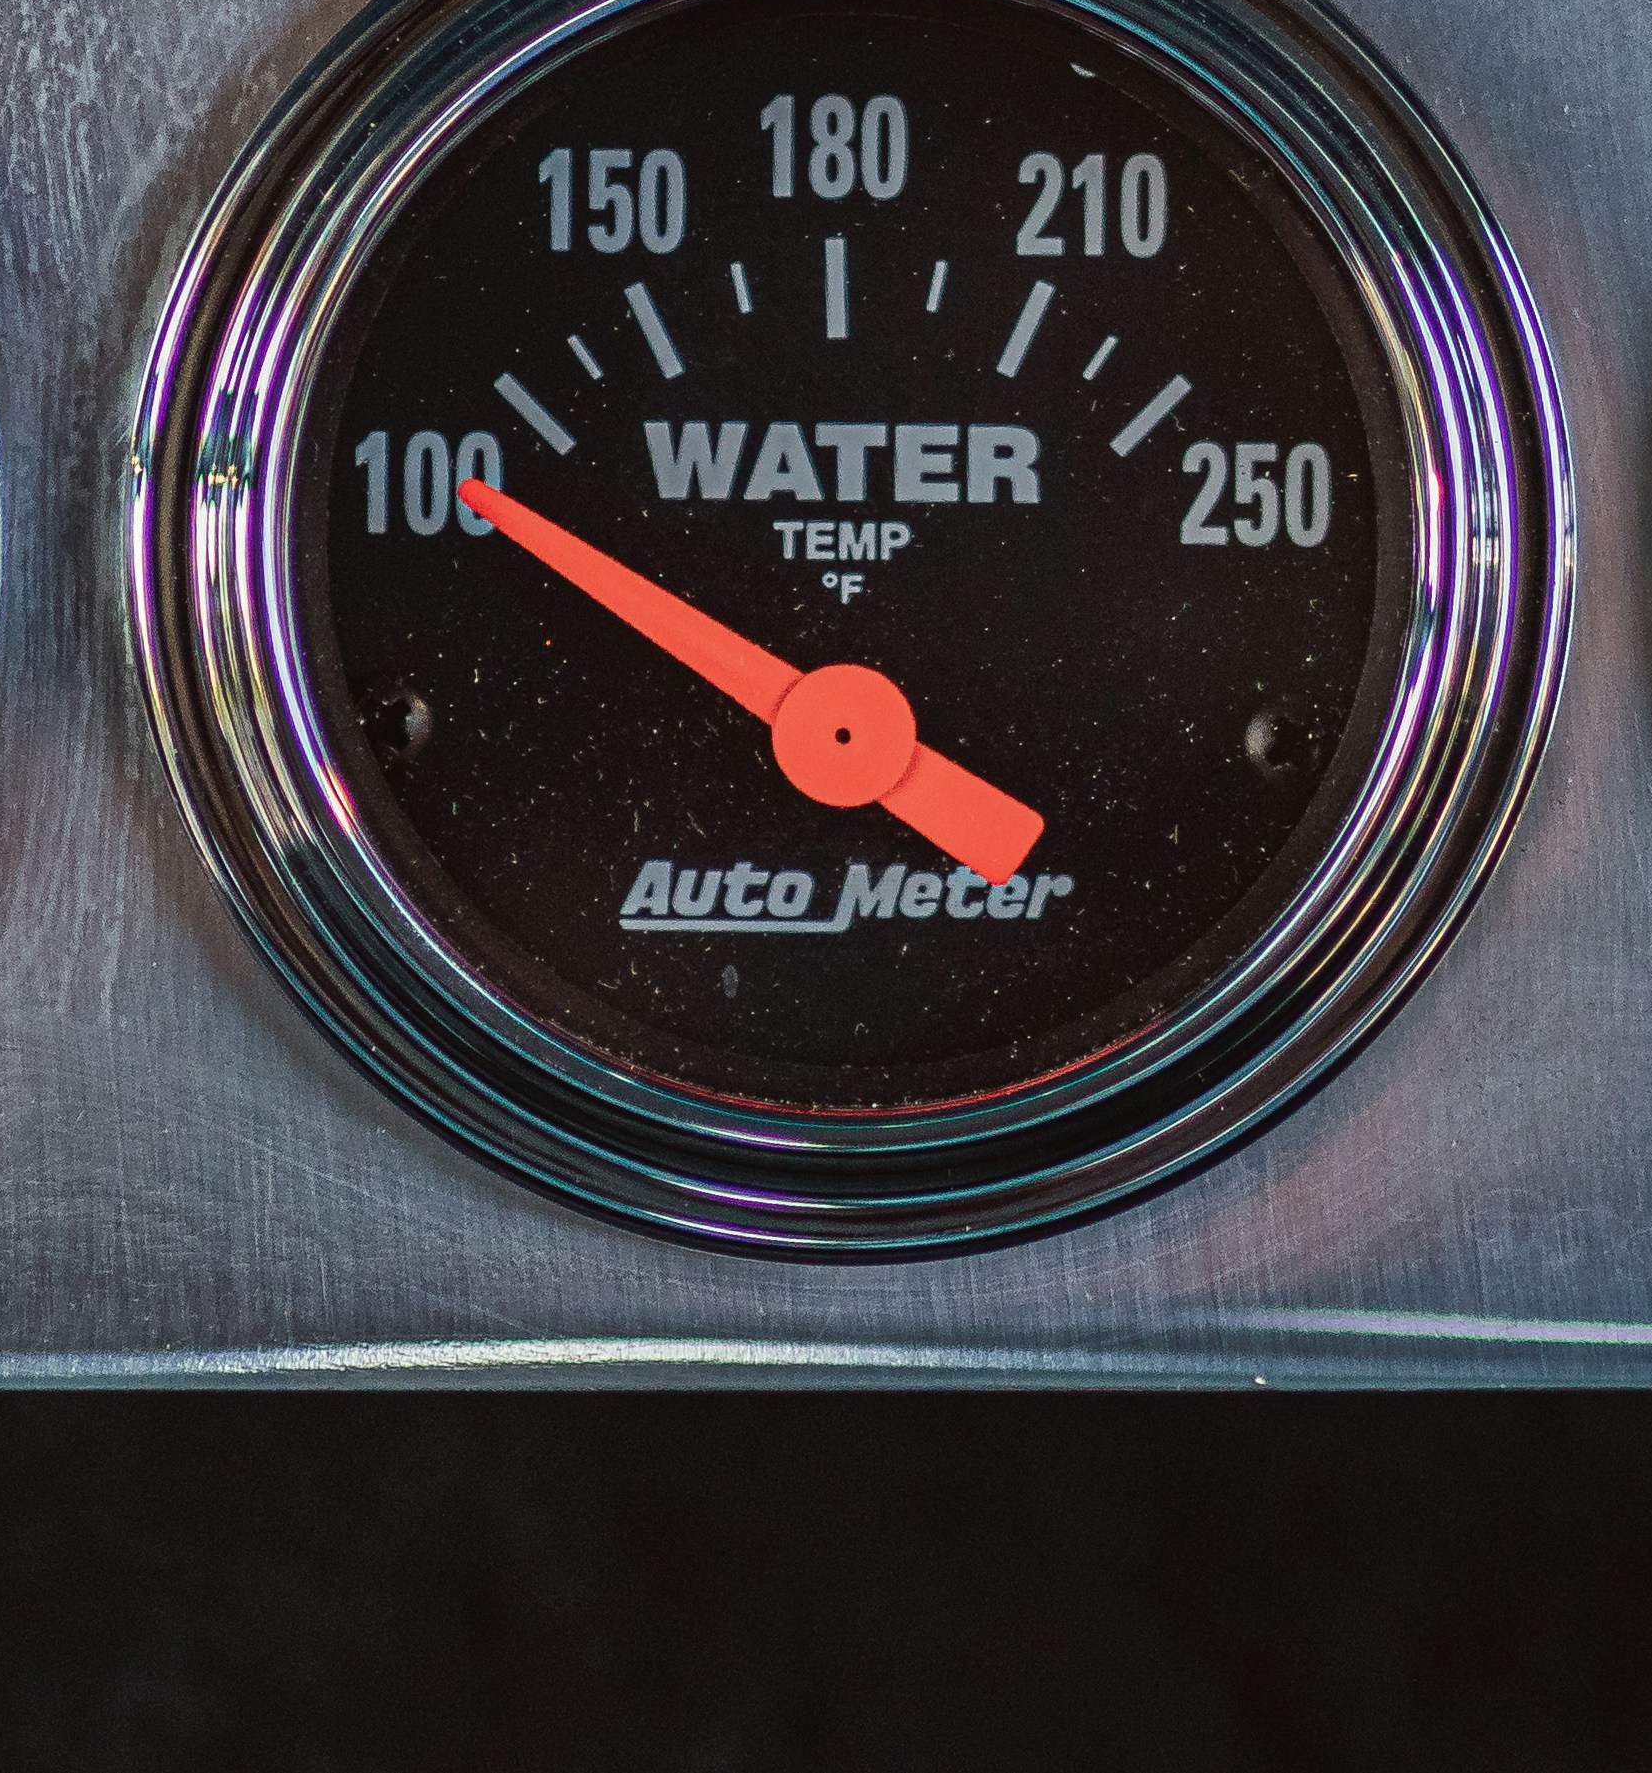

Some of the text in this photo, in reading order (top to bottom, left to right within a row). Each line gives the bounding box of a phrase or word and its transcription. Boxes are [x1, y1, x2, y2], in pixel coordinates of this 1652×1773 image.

[761, 93, 909, 200] 180
[539, 146, 687, 255] 150
[1015, 152, 1168, 258] 210
[354, 430, 503, 537] 100
[643, 420, 1041, 504] WATER
[1180, 442, 1331, 549] 250
[772, 519, 911, 562] TEMP
[619, 860, 1075, 932] Auto Meter
